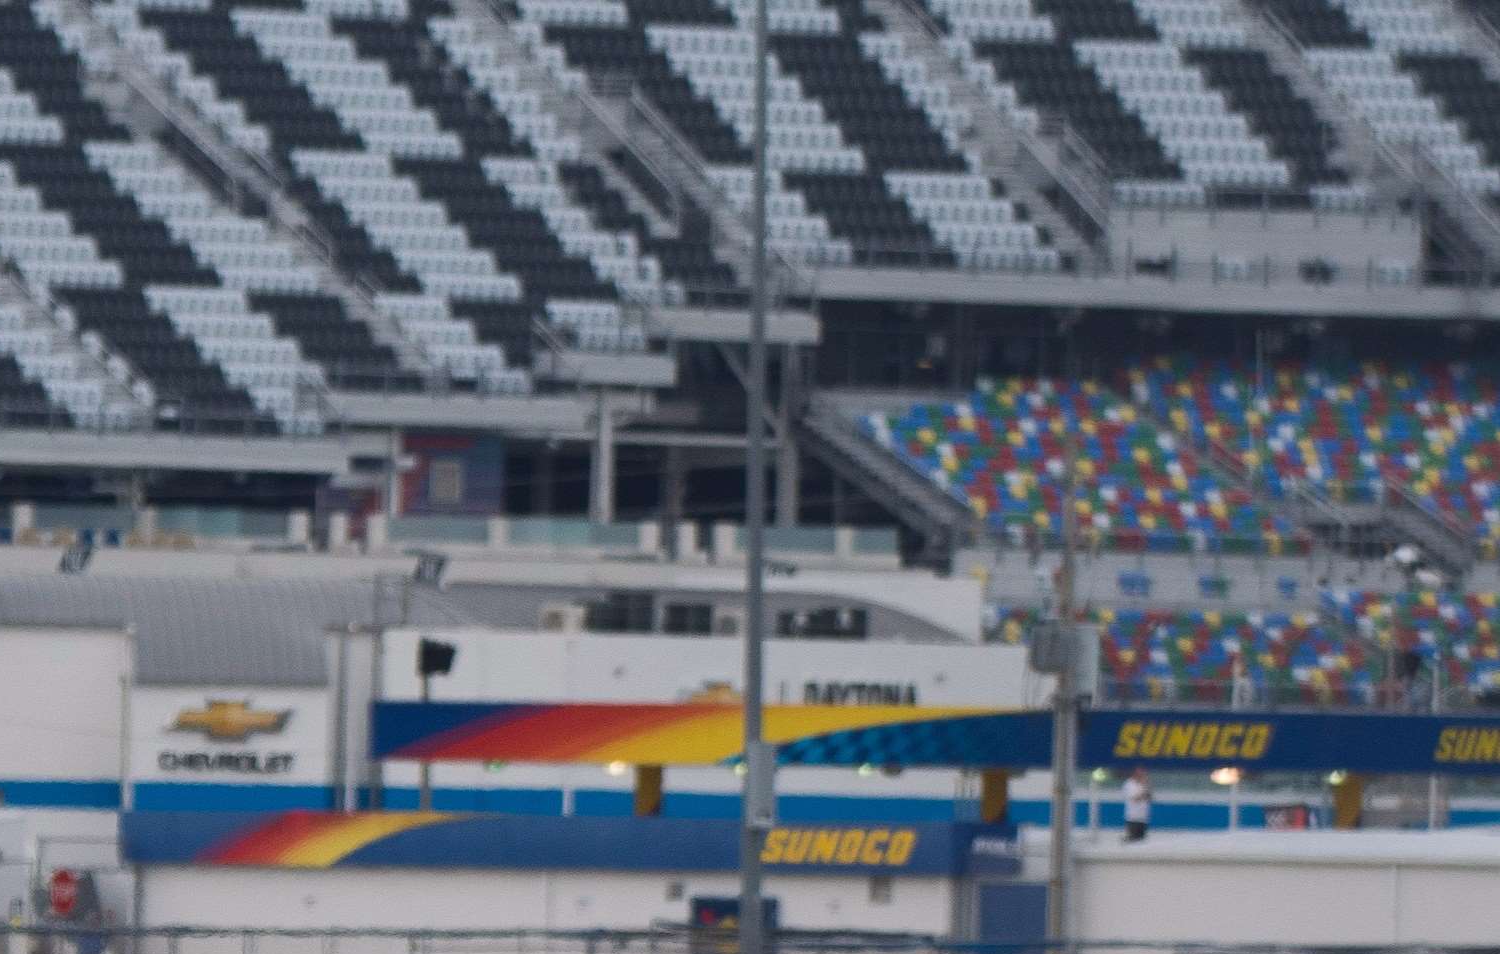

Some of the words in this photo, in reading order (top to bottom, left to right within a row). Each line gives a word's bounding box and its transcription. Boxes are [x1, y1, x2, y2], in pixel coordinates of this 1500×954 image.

[1113, 722, 1272, 760] SUNOCO
[158, 752, 294, 774] CHEVROLET
[760, 827, 917, 865] SUNOCO
